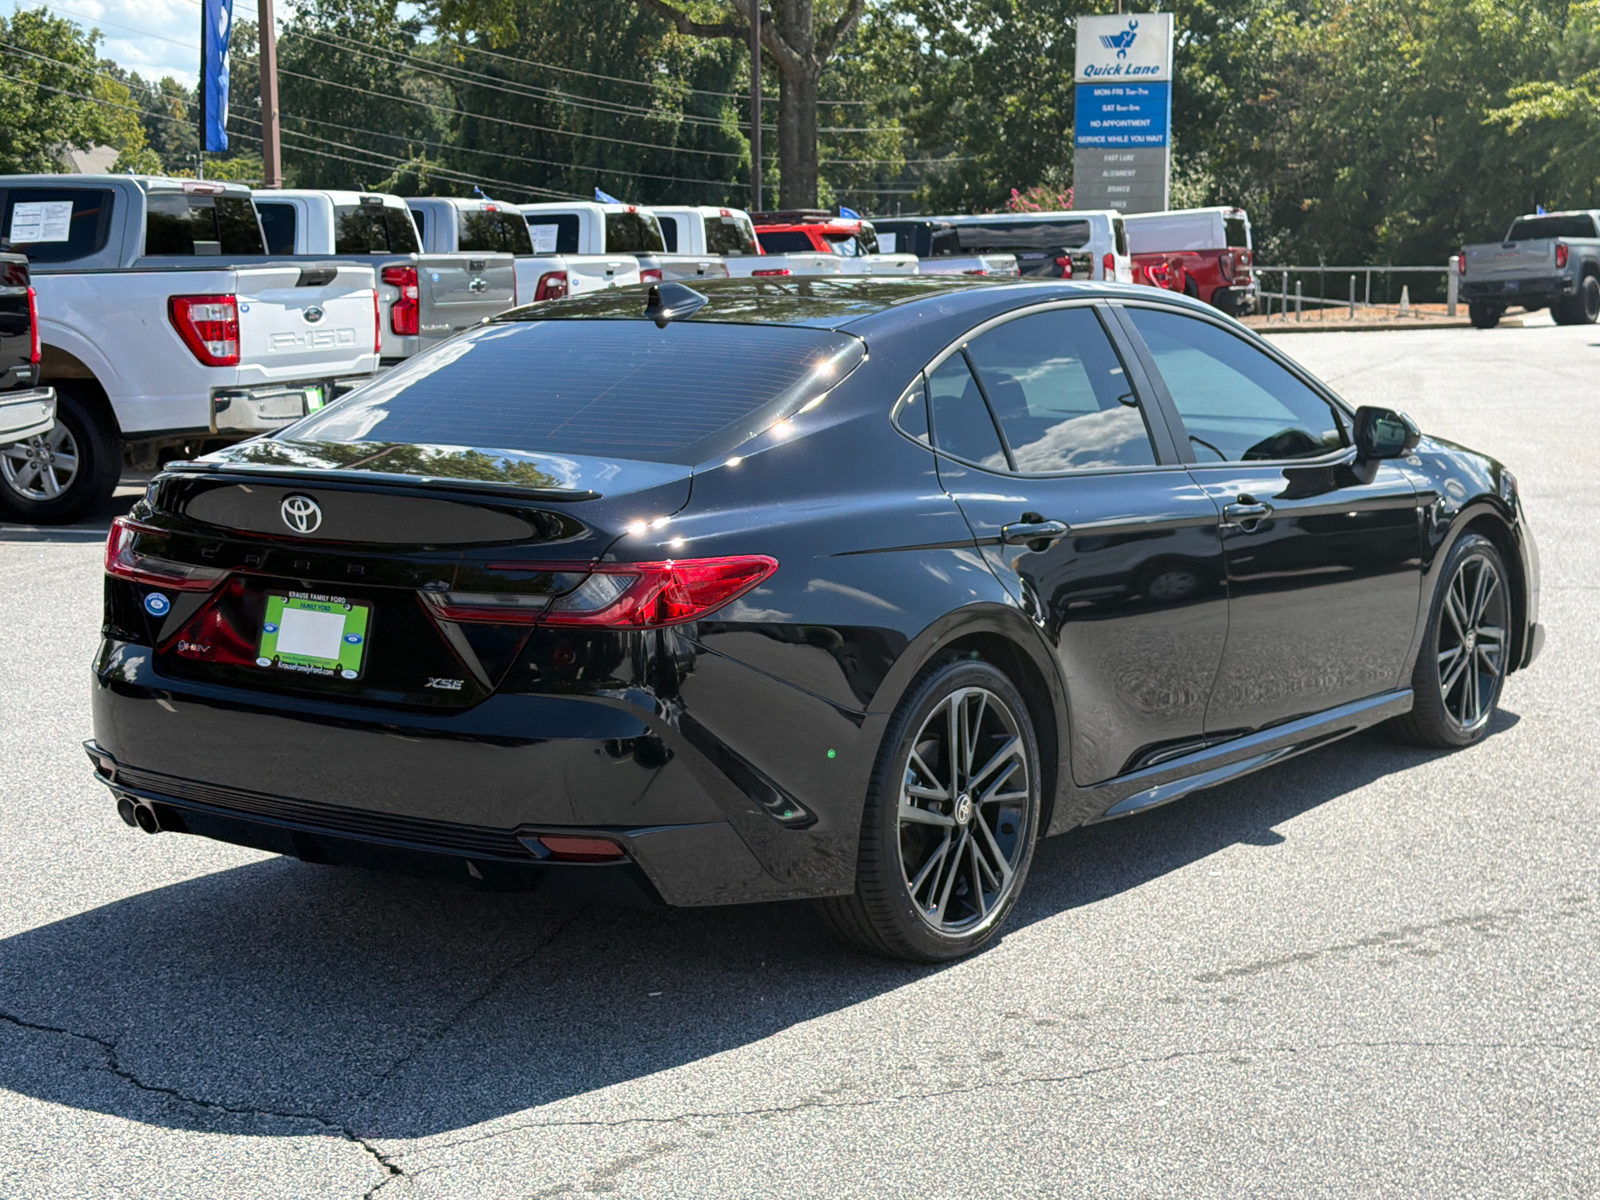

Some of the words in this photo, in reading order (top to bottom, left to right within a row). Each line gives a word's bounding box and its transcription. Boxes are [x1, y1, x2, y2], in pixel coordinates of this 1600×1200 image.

[1083, 63, 1123, 77] Quick
[1124, 63, 1160, 75] Lane
[1102, 104, 1115, 112] SAT
[1090, 120, 1101, 128] NO
[1102, 119, 1151, 127] APPOINTMENT
[1077, 135, 1106, 143] SERVICE
[1107, 135, 1129, 143] WHILE
[268, 328, 356, 352] F-150
[288, 591, 309, 599] KRAUSE
[310, 593, 329, 602] FAMILY
[330, 596, 346, 604] FORD
[300, 602, 317, 610] FAMILY
[424, 677, 464, 690] XSE
